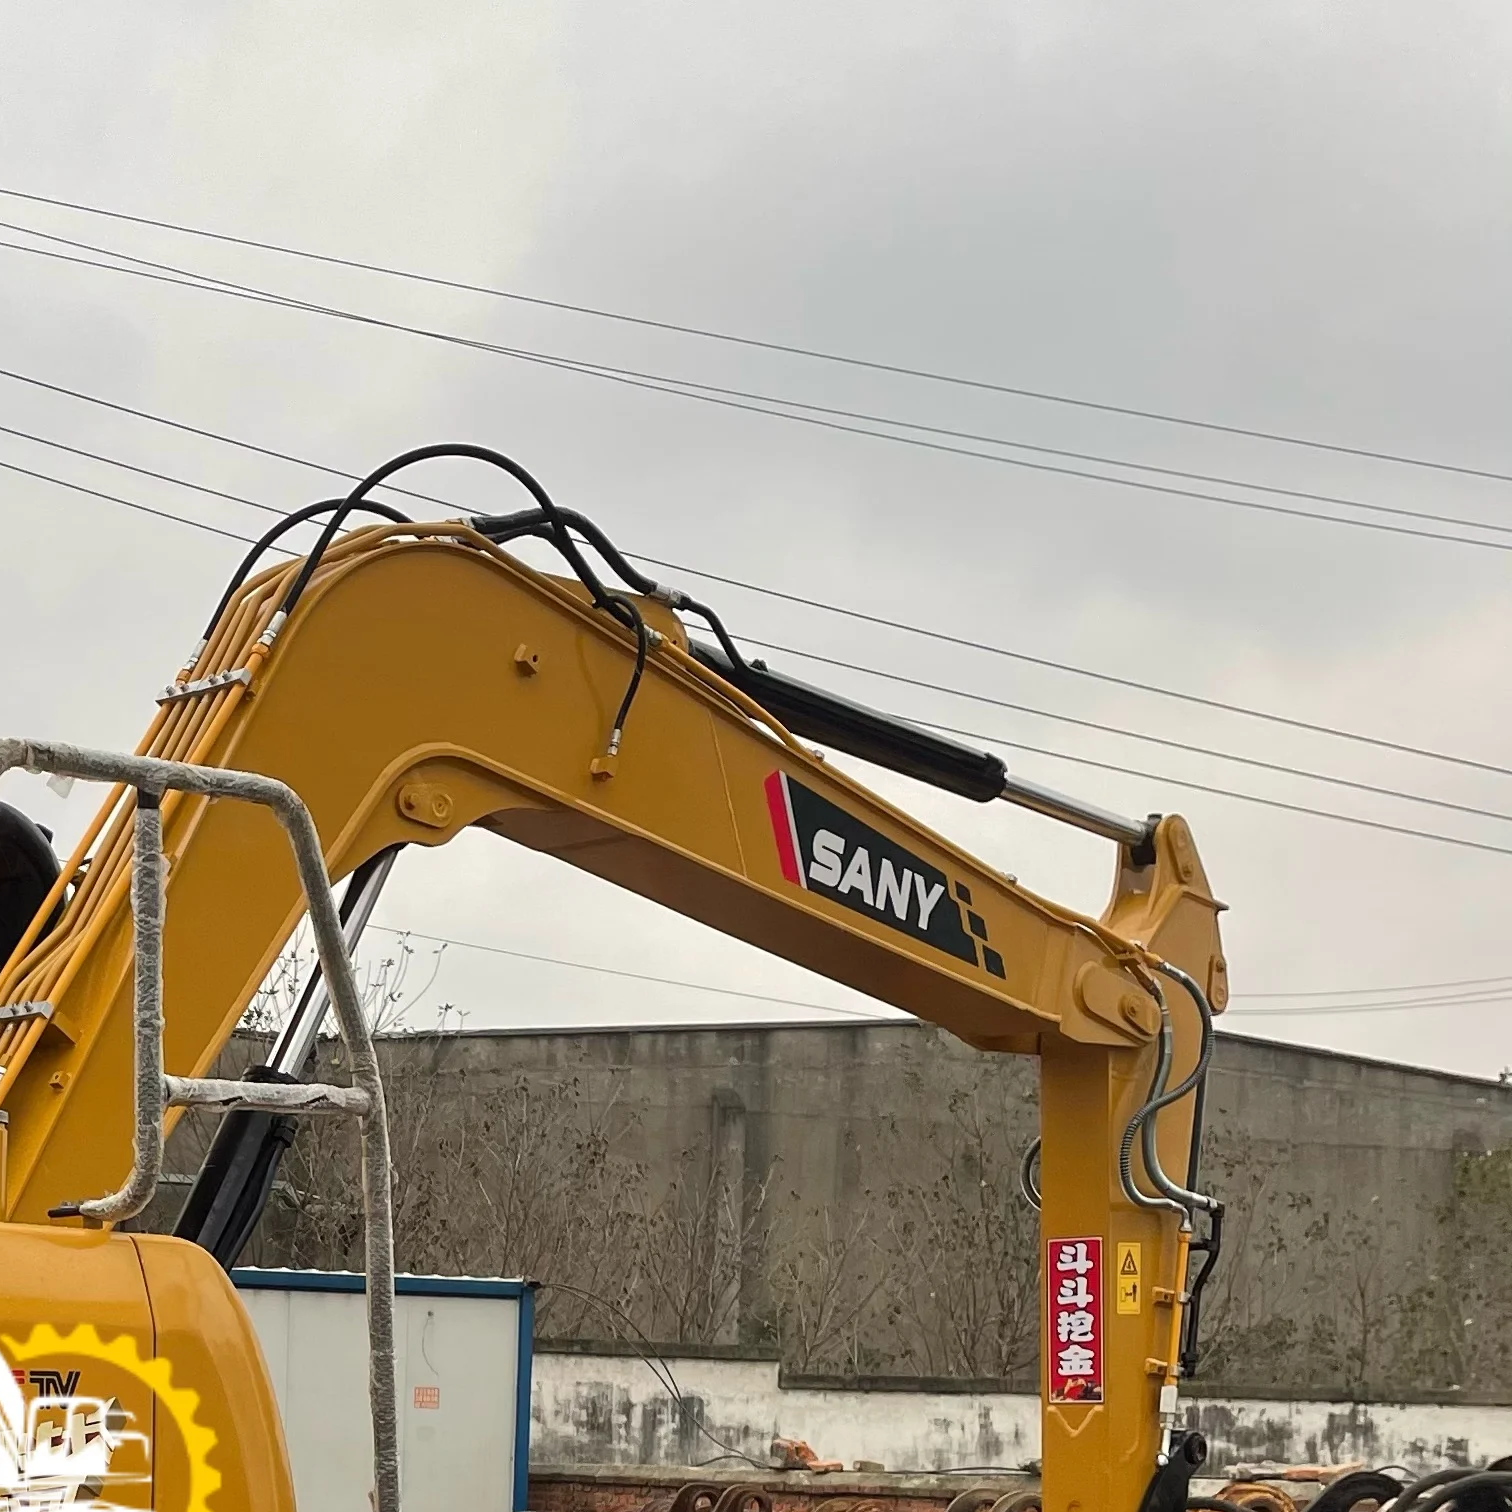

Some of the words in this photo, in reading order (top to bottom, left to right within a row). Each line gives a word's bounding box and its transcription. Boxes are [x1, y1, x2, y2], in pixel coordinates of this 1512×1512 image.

[809, 829, 945, 931] SANY
[1056, 1242, 1095, 1376] 斗斗挖金
